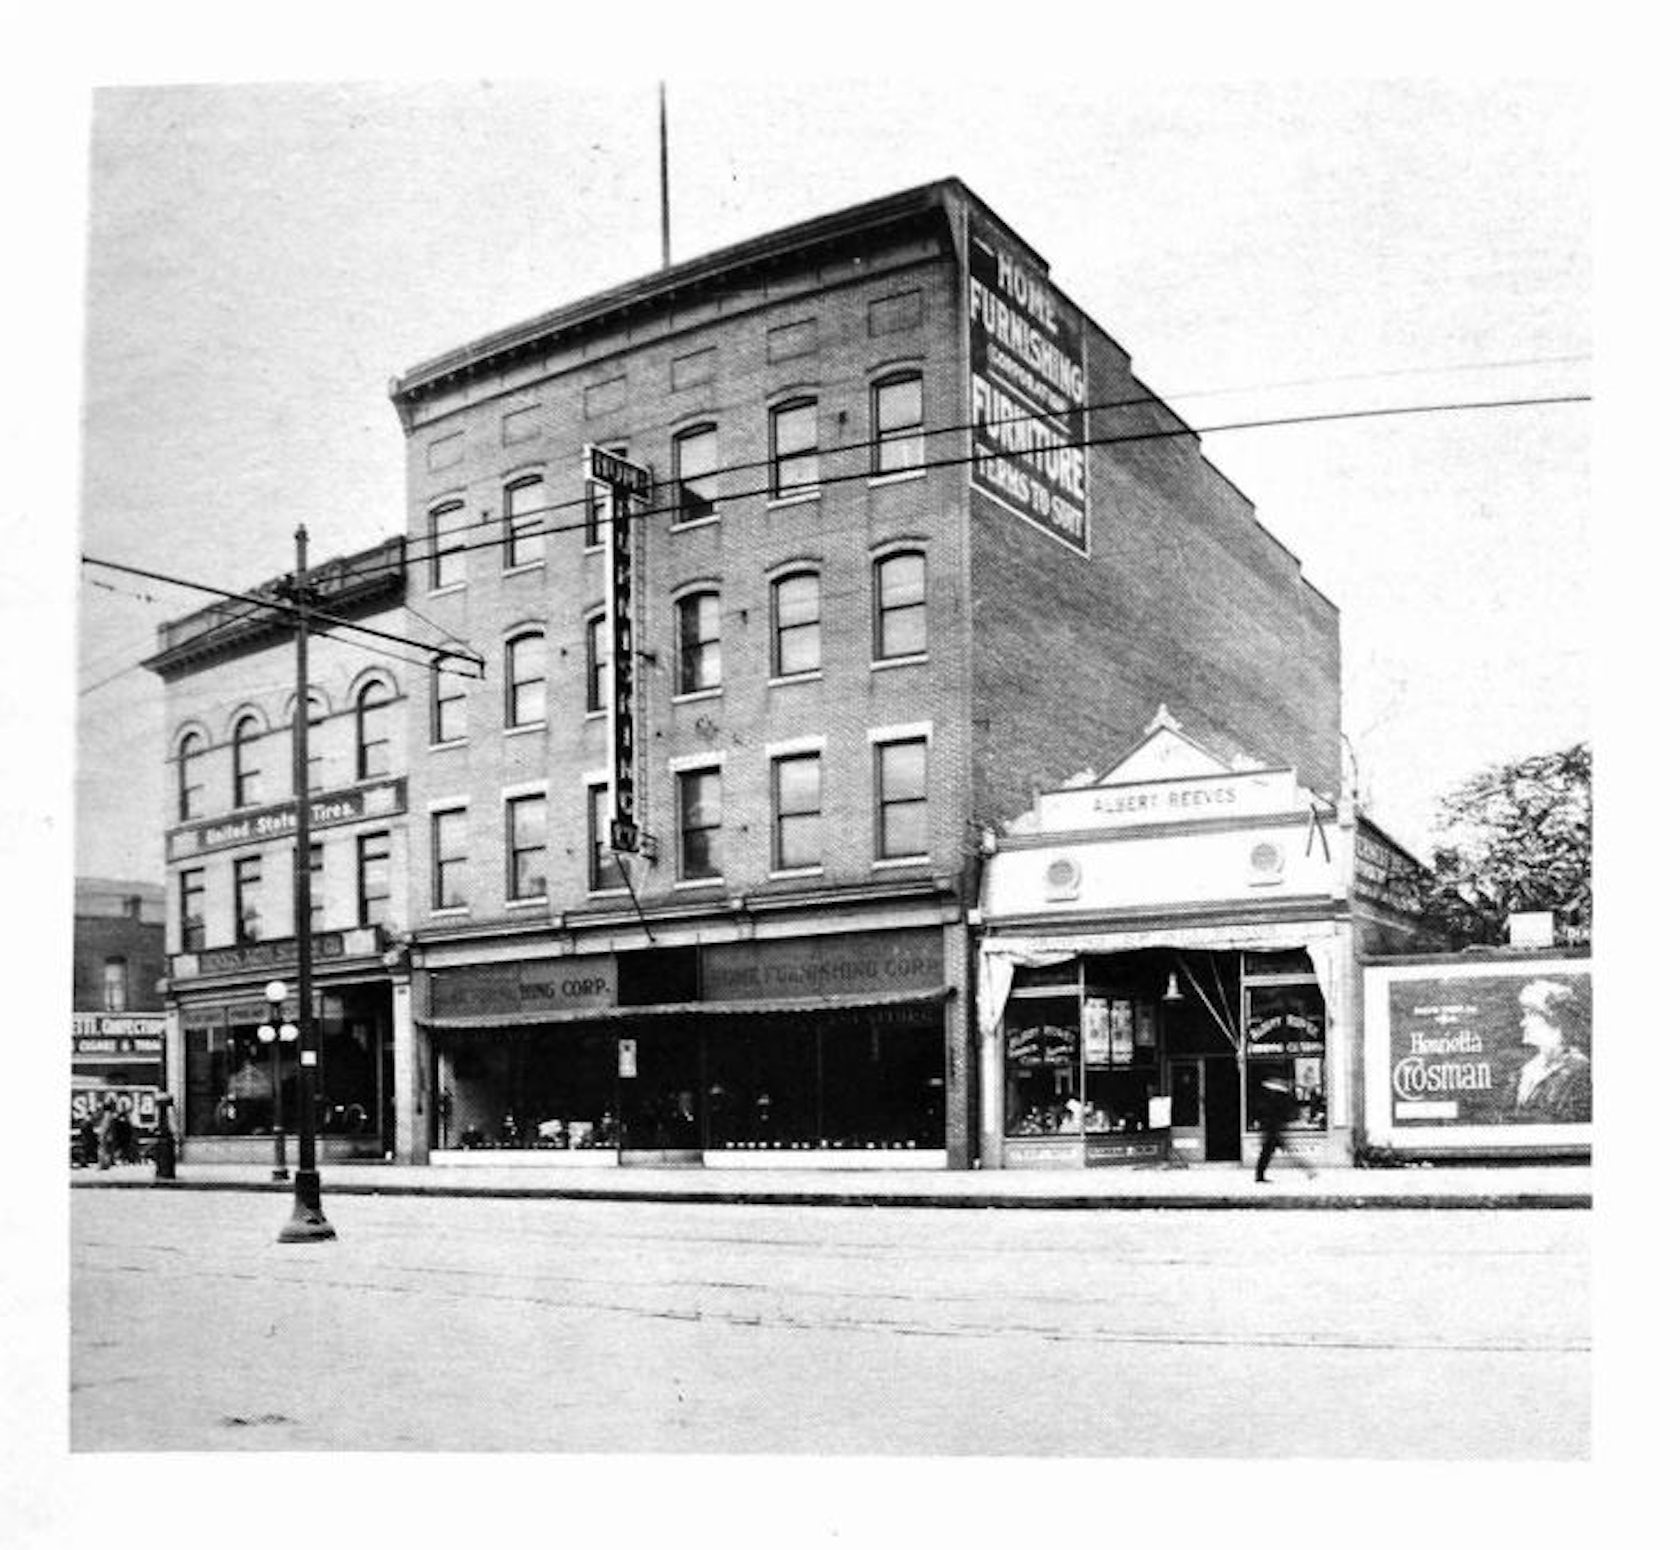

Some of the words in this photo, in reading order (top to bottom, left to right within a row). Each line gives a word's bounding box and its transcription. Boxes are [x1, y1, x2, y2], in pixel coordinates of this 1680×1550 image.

[997, 250, 1060, 335] HOME
[970, 275, 1084, 403] FURNISHING
[973, 374, 1086, 501] FURNITURE
[975, 442, 1031, 504] TERMS
[1030, 480, 1050, 516] TO
[257, 812, 298, 833] State
[1093, 794, 1158, 813] ALBERT
[1169, 788, 1237, 808] REEVES
[561, 977, 610, 997] CORP.
[1410, 1030, 1483, 1054] Henrietta
[1393, 1055, 1494, 1101] Crosman
